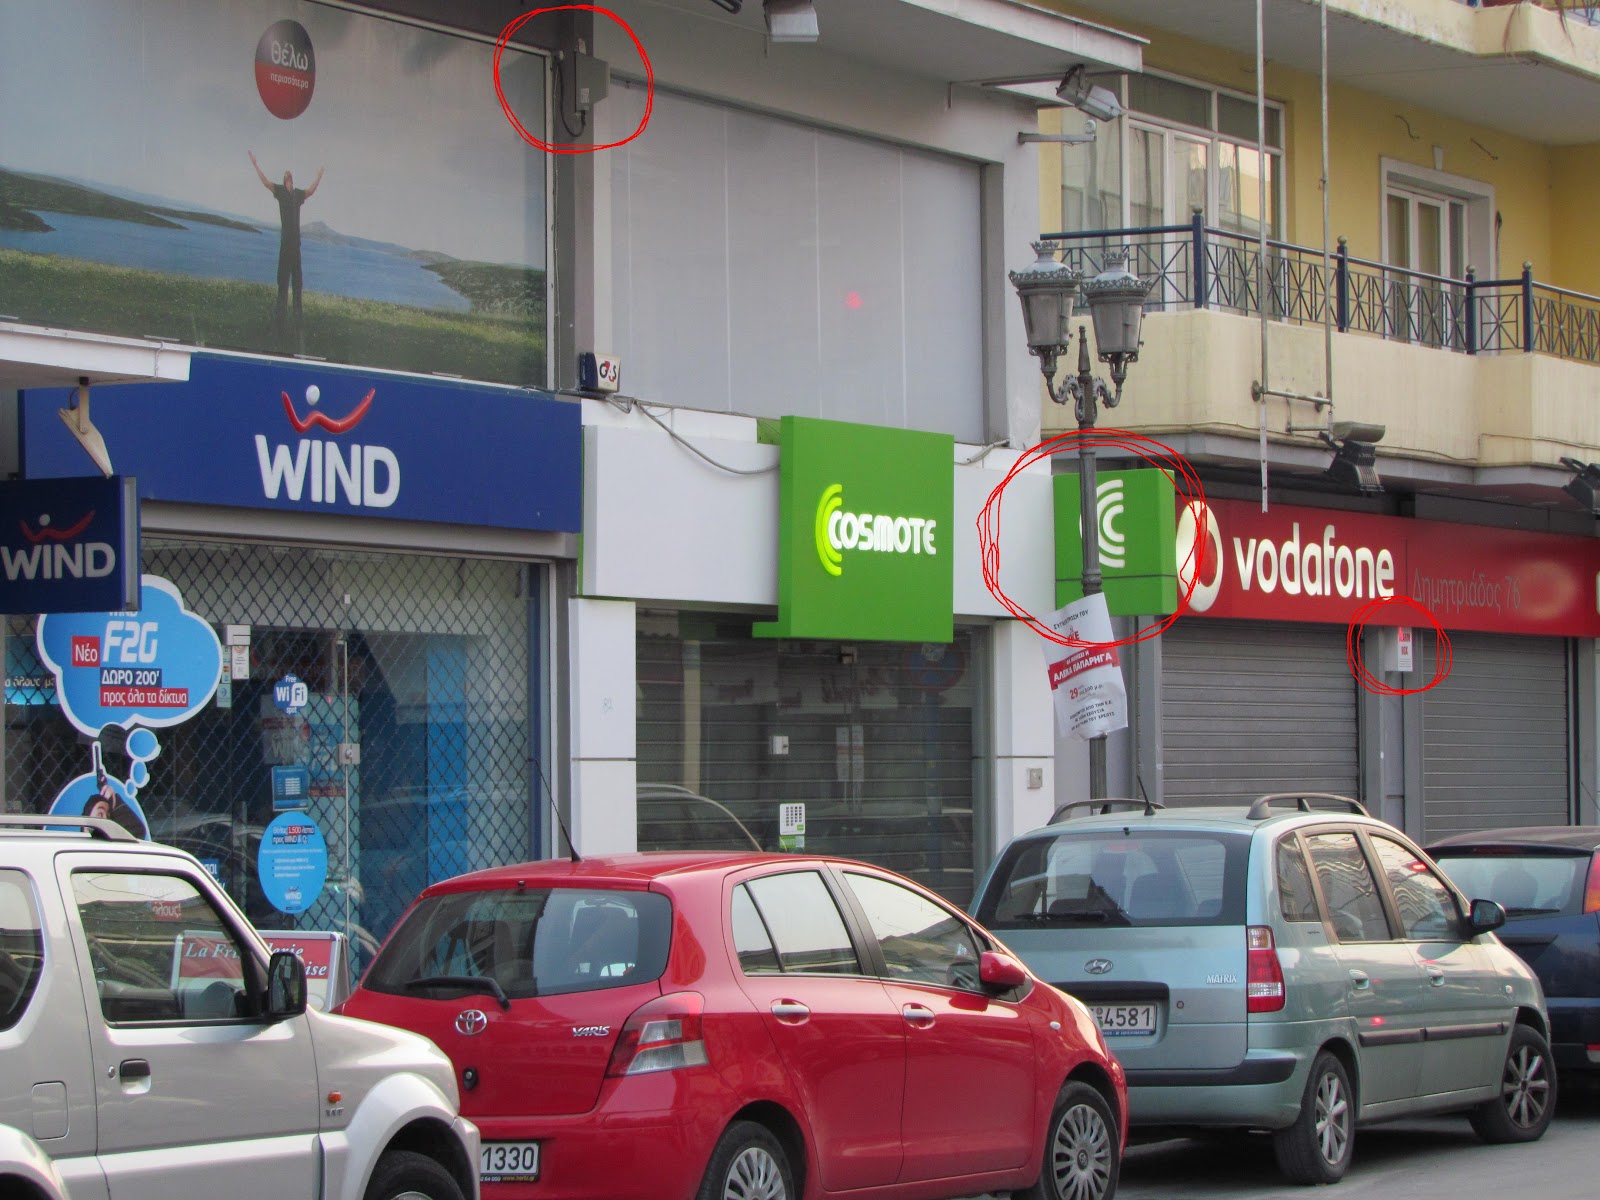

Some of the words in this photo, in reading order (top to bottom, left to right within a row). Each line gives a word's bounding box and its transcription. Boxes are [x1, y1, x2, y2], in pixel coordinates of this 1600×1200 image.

[255, 434, 400, 508] WIND
[828, 510, 937, 555] COSMOTE
[0, 542, 116, 580] WIND
[1233, 522, 1395, 600] vodafone
[1412, 568, 1501, 615] Δημητριάδος
[1505, 575, 1521, 609] 76
[75, 643, 98, 662] Νέο
[102, 621, 159, 663] F2G
[101, 669, 133, 685] ΔΩΡΟ
[1053, 667, 1073, 681] ΑΛΕΚΑ
[1072, 652, 1113, 673] ΠΑΠΑΡΗΓΑ
[285, 675, 297, 683] Free
[103, 691, 126, 706] προς
[127, 688, 145, 703] όλα
[146, 692, 157, 704] τα
[158, 688, 187, 704] δίκτυα
[1069, 687, 1078, 700] 29
[185, 942, 208, 958] La
[1206, 974, 1237, 984] MATRIX
